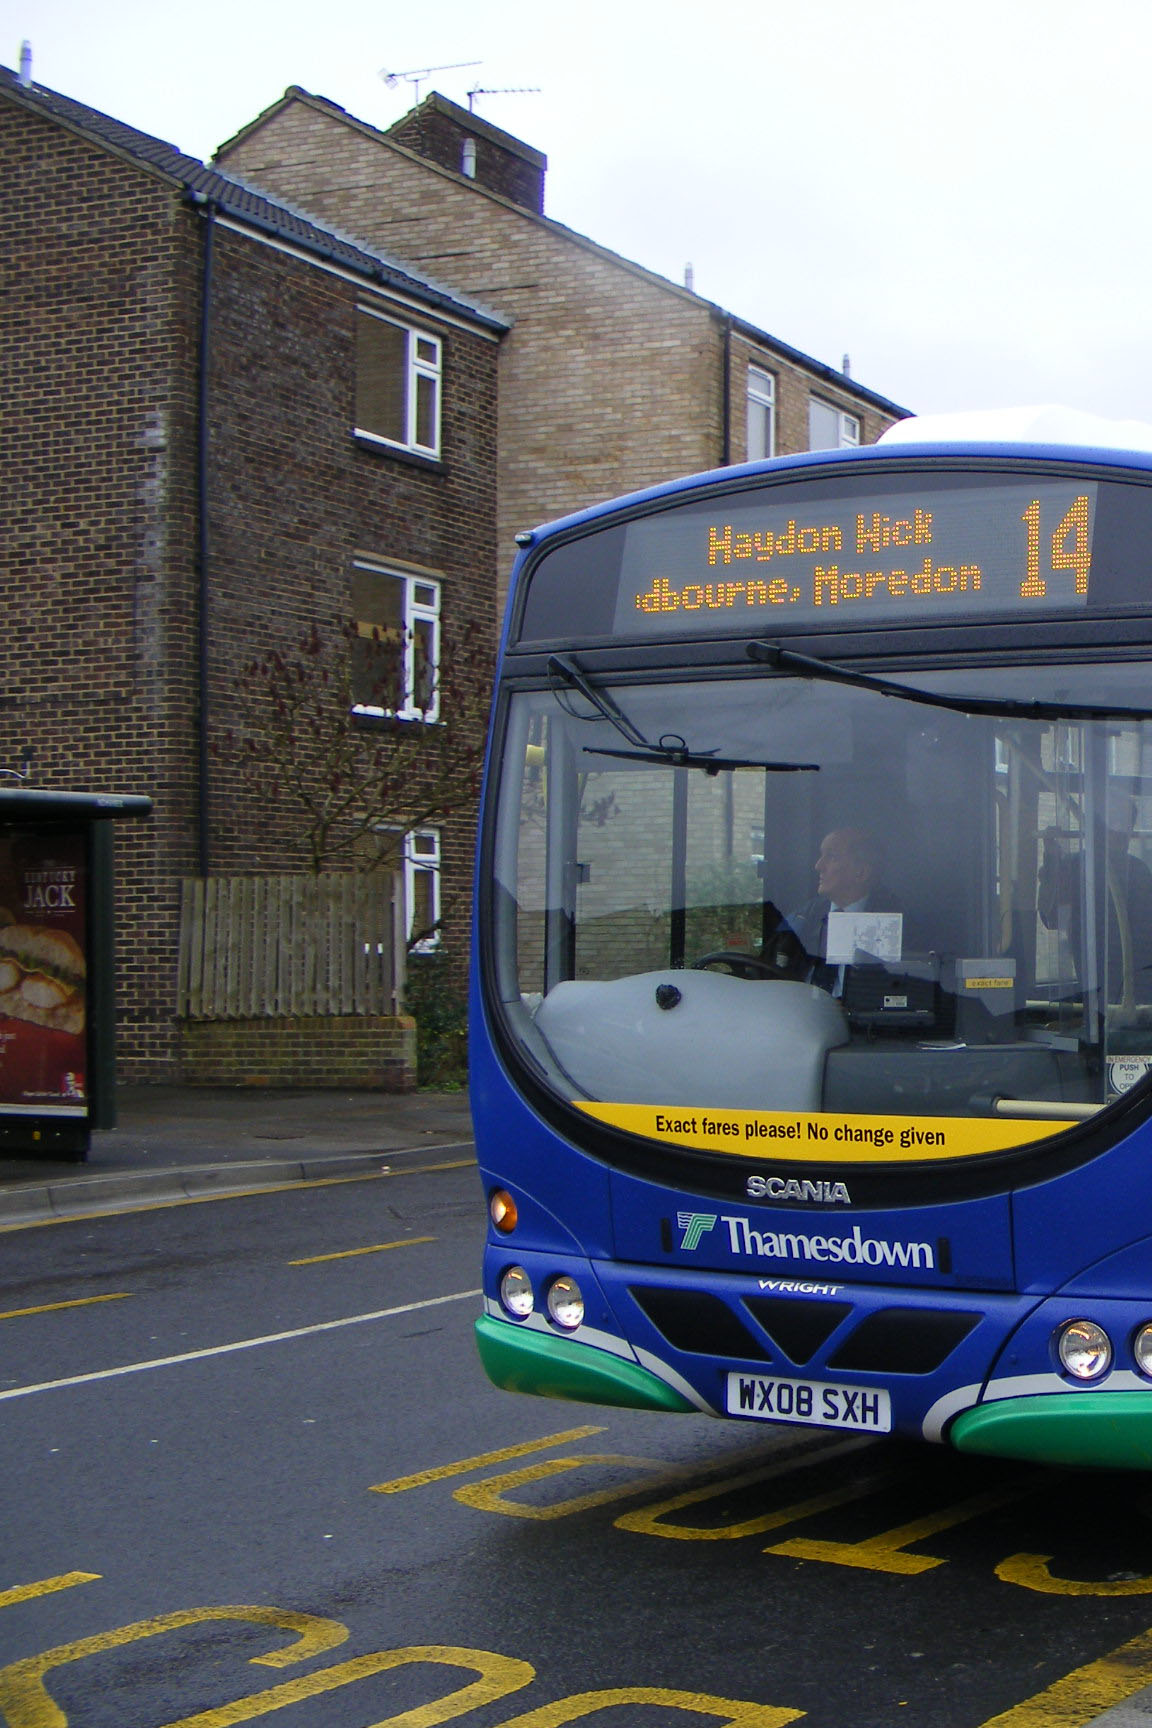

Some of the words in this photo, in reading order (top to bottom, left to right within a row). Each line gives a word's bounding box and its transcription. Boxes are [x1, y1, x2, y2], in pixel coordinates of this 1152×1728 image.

[707, 519, 843, 565] Haydon
[856, 508, 933, 553] Wick
[1020, 496, 1092, 597] 14
[635, 577, 801, 612] dbourne,
[813, 557, 982, 606] Moredon
[23, 884, 76, 907] JACK
[1119, 1063, 1140, 1071] PUSH
[1124, 1073, 1135, 1081] TO
[655, 1115, 697, 1133] Exact
[702, 1118, 740, 1136] fares
[745, 1119, 801, 1140] please!
[807, 1122, 829, 1140] No
[834, 1124, 894, 1147] change
[900, 1127, 946, 1148] given
[746, 1175, 851, 1203] SCANIA
[720, 1215, 935, 1269] Thamesdown
[757, 1279, 845, 1296] WRIGHT
[738, 1378, 813, 1417] WX08
[822, 1387, 879, 1426] SXH
